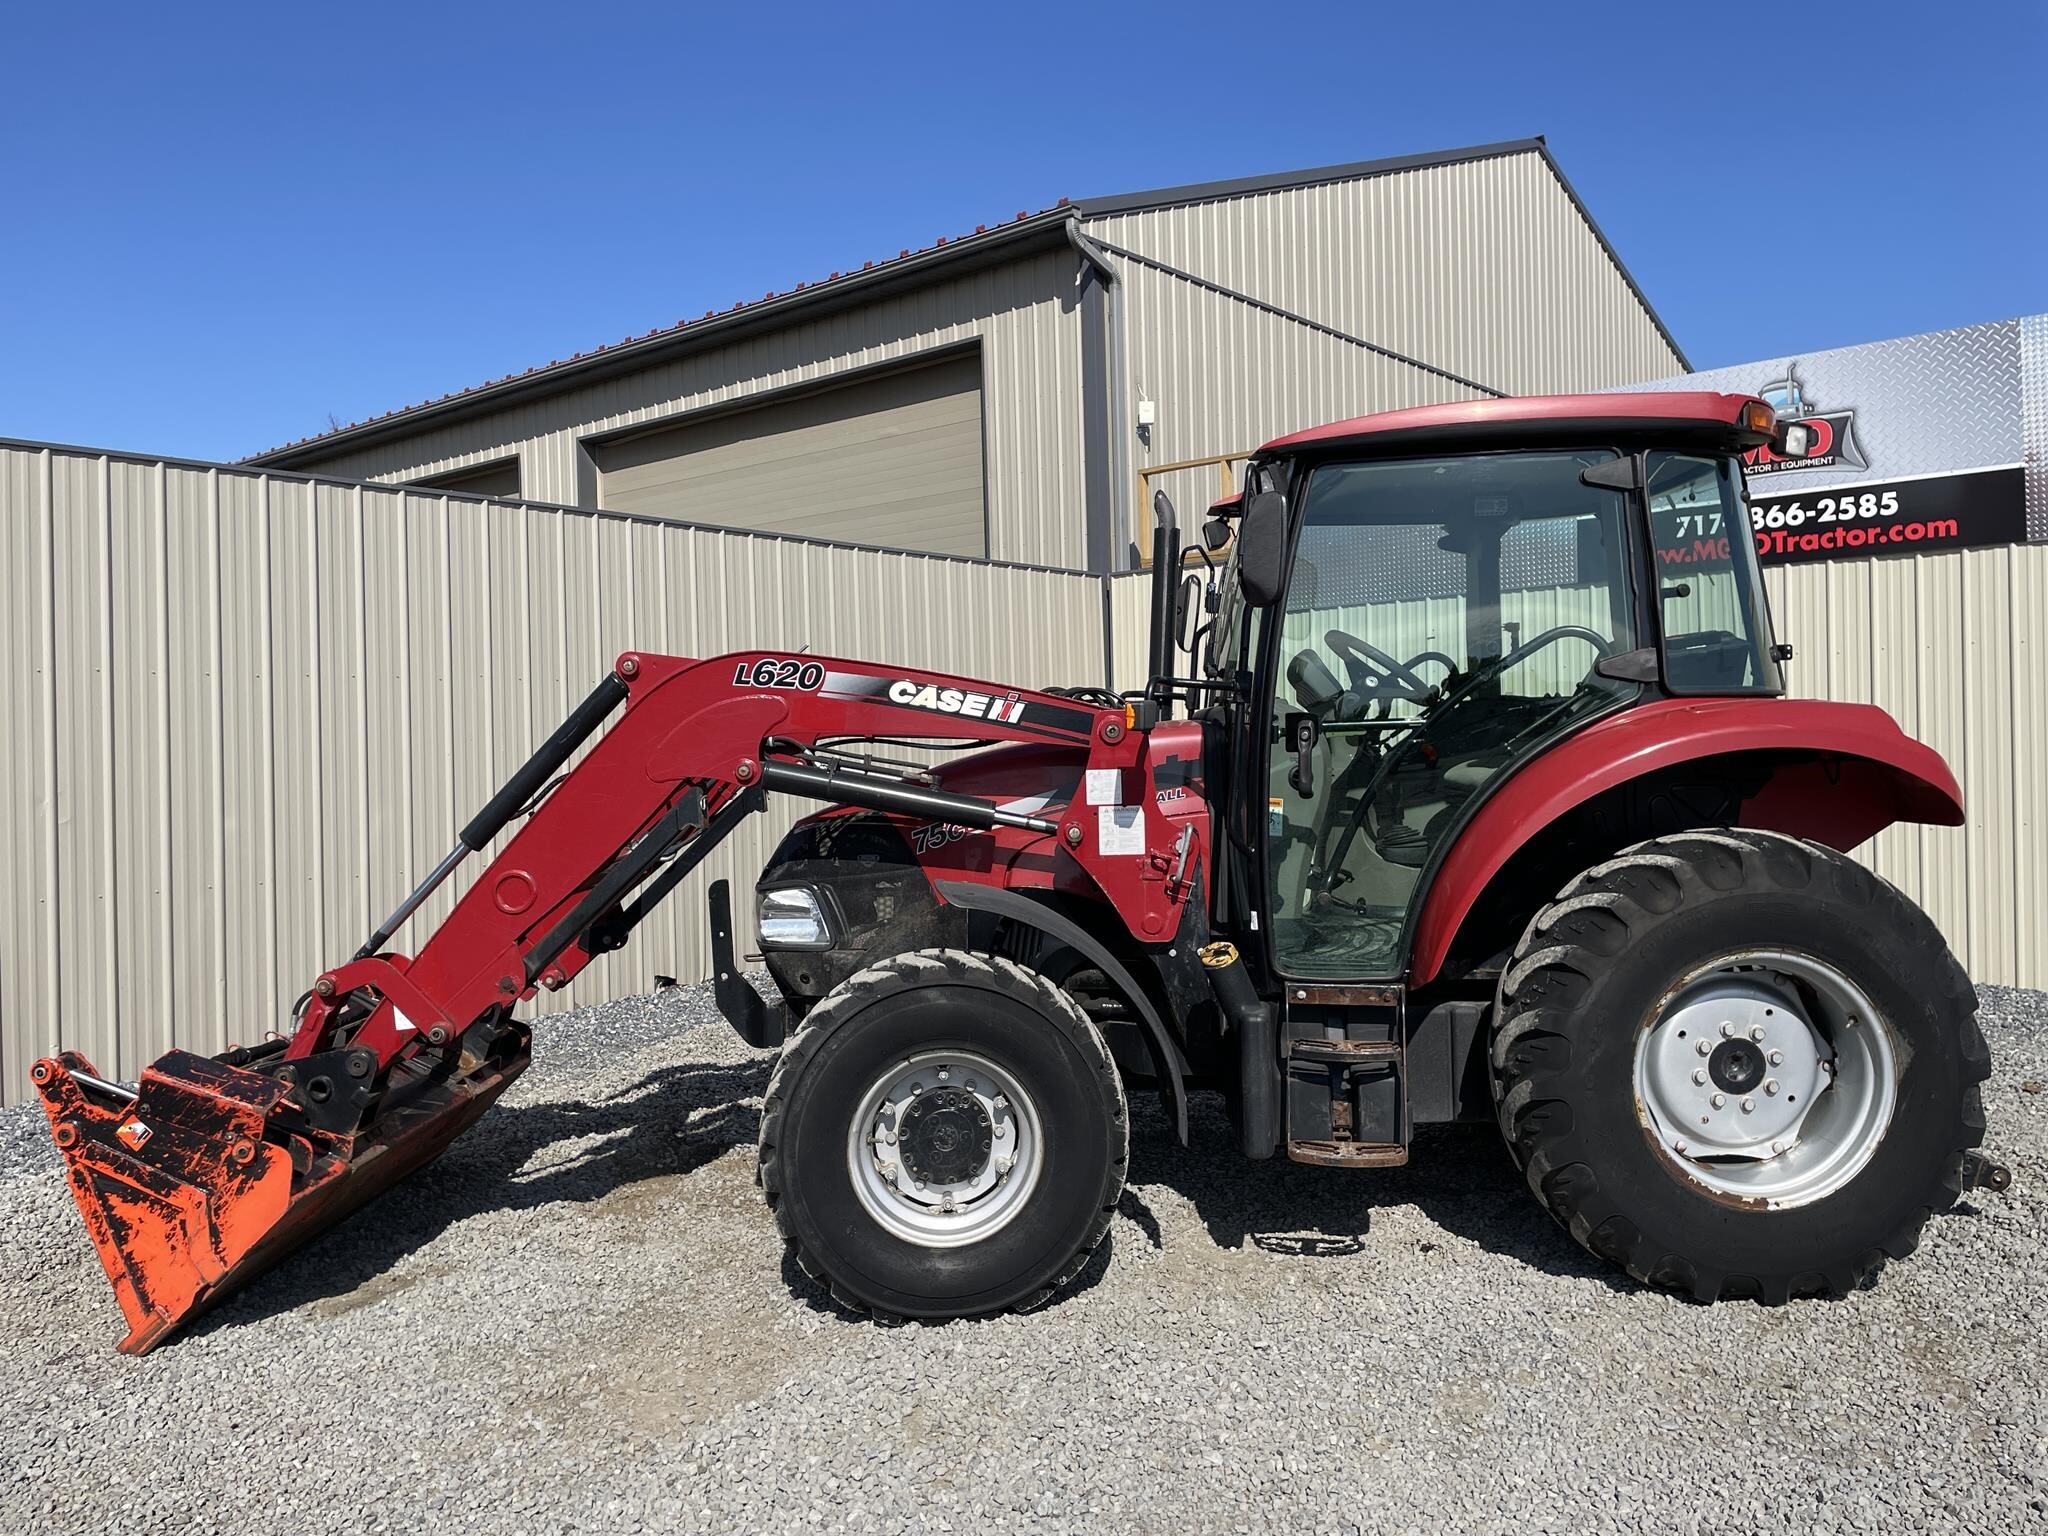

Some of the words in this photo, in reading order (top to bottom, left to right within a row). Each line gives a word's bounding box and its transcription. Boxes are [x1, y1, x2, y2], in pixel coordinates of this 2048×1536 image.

[1743, 464, 1772, 474] ACTOR
[1781, 456, 1834, 470] EQUIPMENT
[1676, 491, 1899, 538] 717866-2585
[733, 659, 824, 690] L620
[888, 680, 990, 718] CASE
